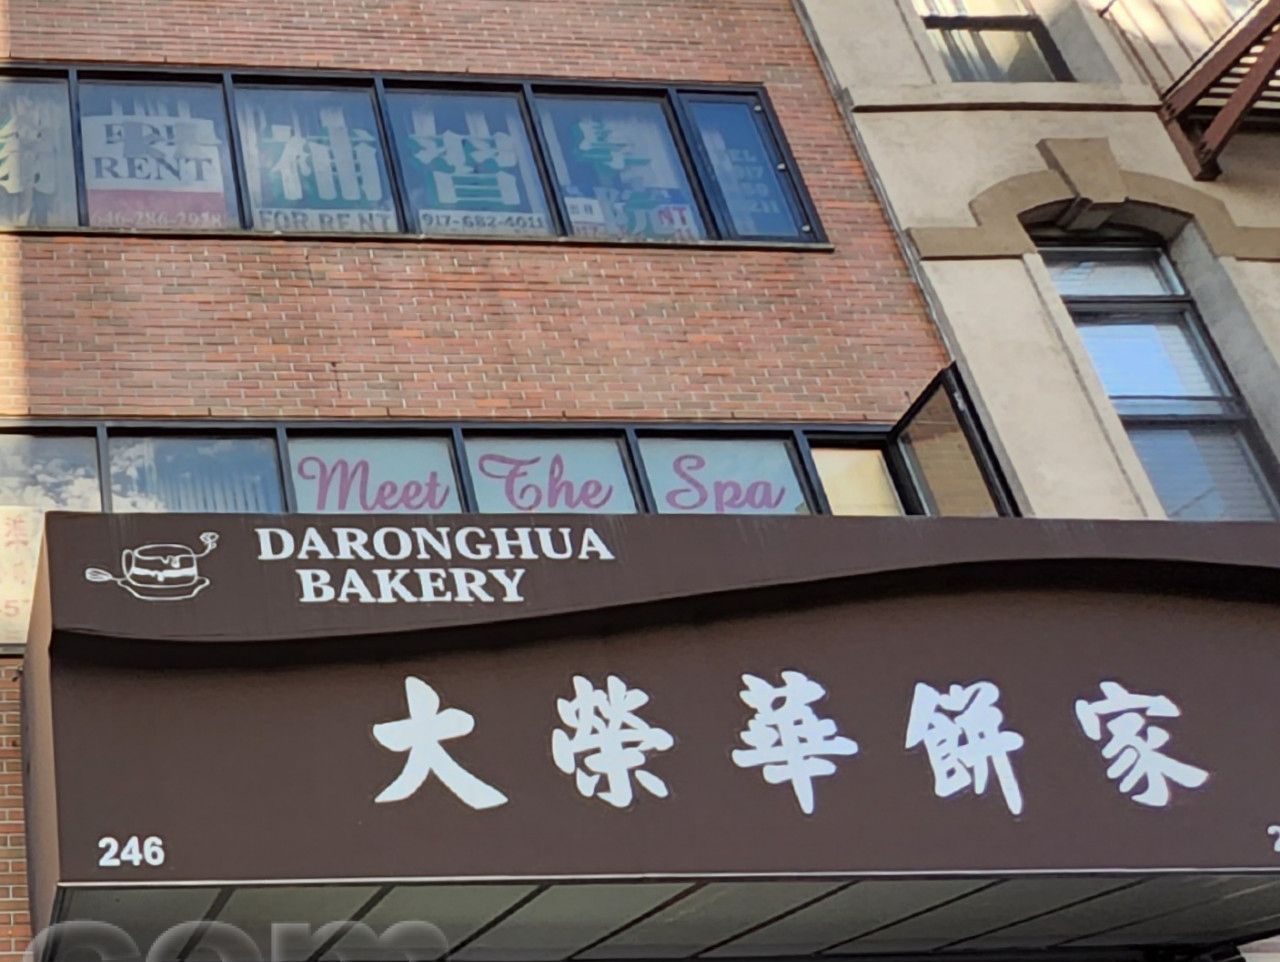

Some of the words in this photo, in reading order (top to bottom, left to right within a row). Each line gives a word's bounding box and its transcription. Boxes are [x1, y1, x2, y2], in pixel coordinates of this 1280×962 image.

[93, 156, 213, 182] RENT
[259, 210, 310, 231] FOR
[317, 211, 393, 233] RENT
[296, 455, 451, 513] Meet
[477, 452, 614, 513] The
[664, 453, 787, 514] Spa
[255, 526, 615, 562] DARONGHUA
[294, 567, 526, 603] BAKERY
[372, 670, 1210, 816] 大榮華餅家
[97, 835, 165, 867] 246
